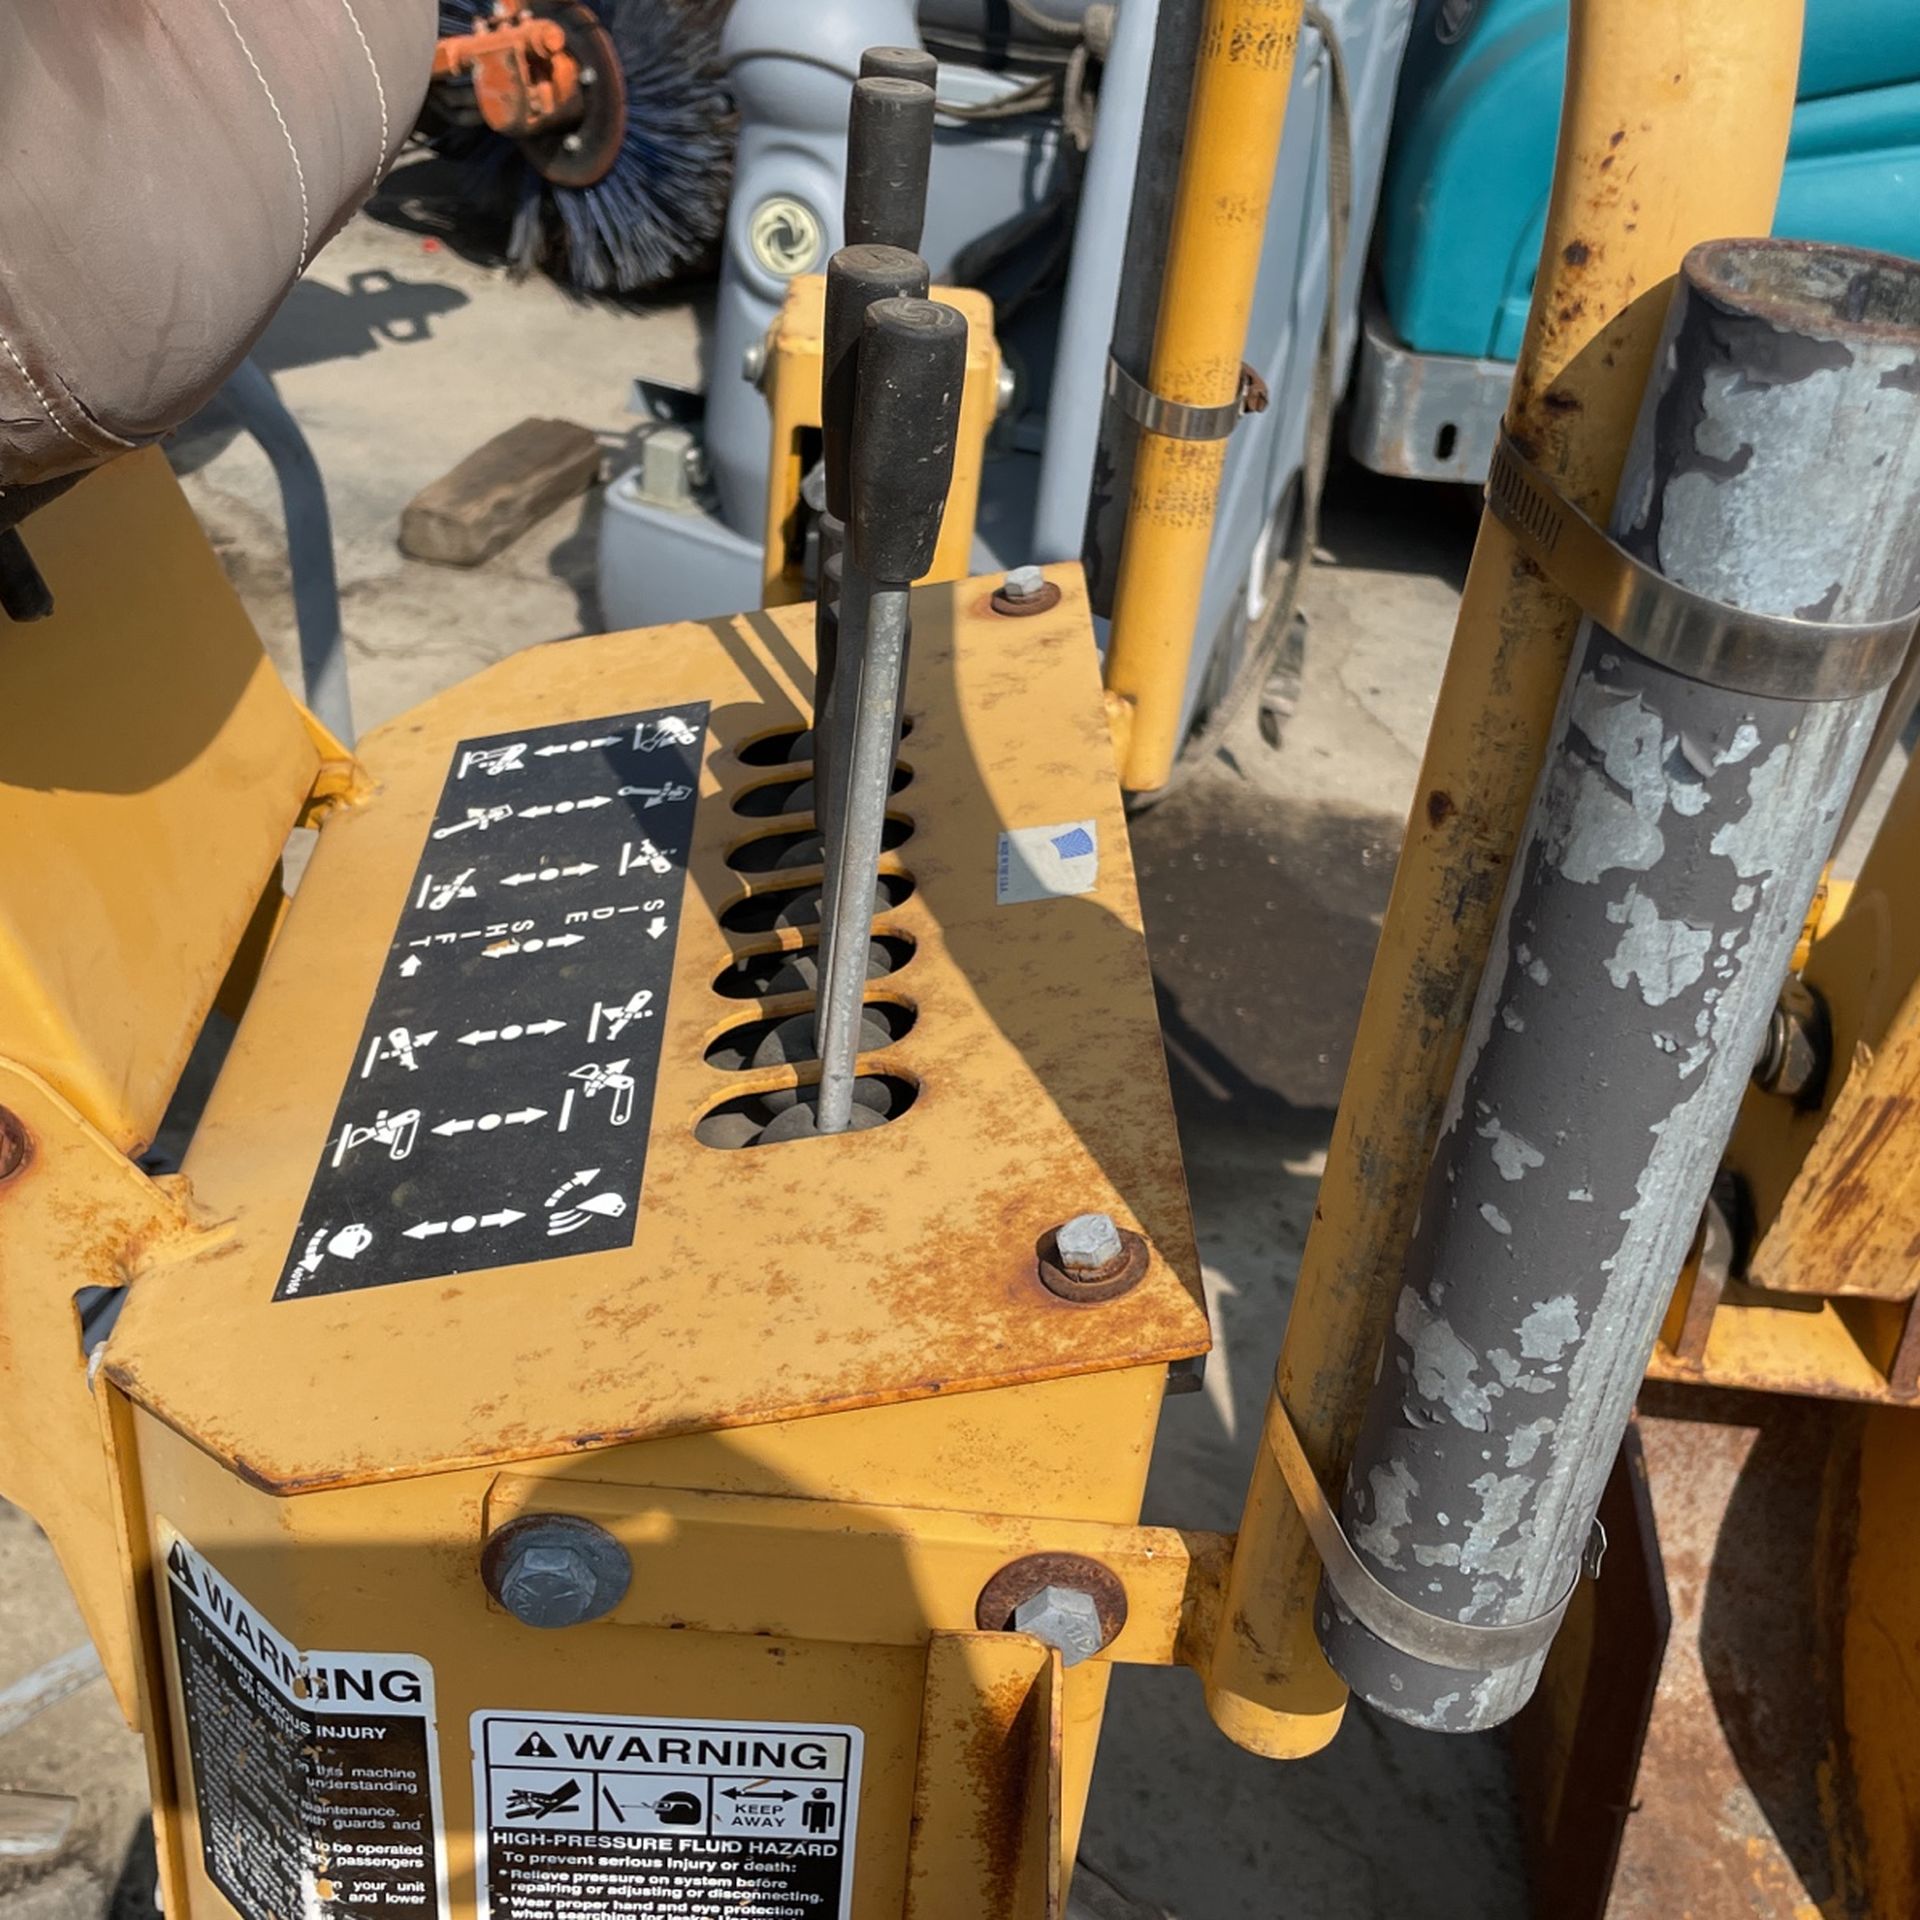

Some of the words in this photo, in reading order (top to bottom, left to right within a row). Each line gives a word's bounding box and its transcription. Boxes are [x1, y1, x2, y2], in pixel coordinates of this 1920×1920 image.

[564, 898, 666, 926] SIDE
[408, 918, 535, 948] SHIFT
[202, 1571, 422, 1704] WARNING
[316, 1724, 387, 1741] INJURY
[564, 1732, 828, 1771] WARNING
[351, 1767, 417, 1780] machine
[305, 1776, 418, 1795] understanding
[300, 1798, 400, 1818] maintenance.
[734, 1803, 784, 1816] KEEP
[332, 1818, 386, 1832] guards
[392, 1819, 422, 1832] and
[730, 1815, 786, 1828] AWAY
[314, 1839, 331, 1853] to
[332, 1841, 353, 1855] be
[355, 1844, 424, 1857] operated
[492, 1831, 673, 1851] HIGH-PRESSURE
[678, 1838, 743, 1854] FLUID
[749, 1841, 838, 1858] HAZARD
[336, 1856, 425, 1870] passengers
[503, 1850, 526, 1864] To
[528, 1853, 595, 1867] prevent
[597, 1856, 664, 1869] serious
[719, 1860, 741, 1872] or
[743, 1860, 798, 1874] death:
[352, 1881, 388, 1893] your
[396, 1881, 426, 1893] unit
[510, 1868, 570, 1882] Relieve
[572, 1872, 646, 1886] pressure
[648, 1876, 670, 1886] on
[673, 1876, 733, 1889] system
[735, 1876, 789, 1890] before
[348, 1892, 378, 1903] and
[385, 1892, 427, 1905] lower
[510, 1882, 583, 1896] repairing
[585, 1884, 605, 1896] or
[606, 1884, 684, 1900] adjusting
[686, 1888, 705, 1899] or
[707, 1887, 825, 1905] disconnecting.
[510, 1896, 553, 1908] Wear
[555, 1899, 610, 1912] proper
[612, 1900, 654, 1912] hand
[656, 1901, 688, 1913] and
[690, 1904, 722, 1916] eye
[722, 1904, 805, 1918] protection
[510, 1908, 554, 1919] when
[556, 1910, 637, 1920] searching
